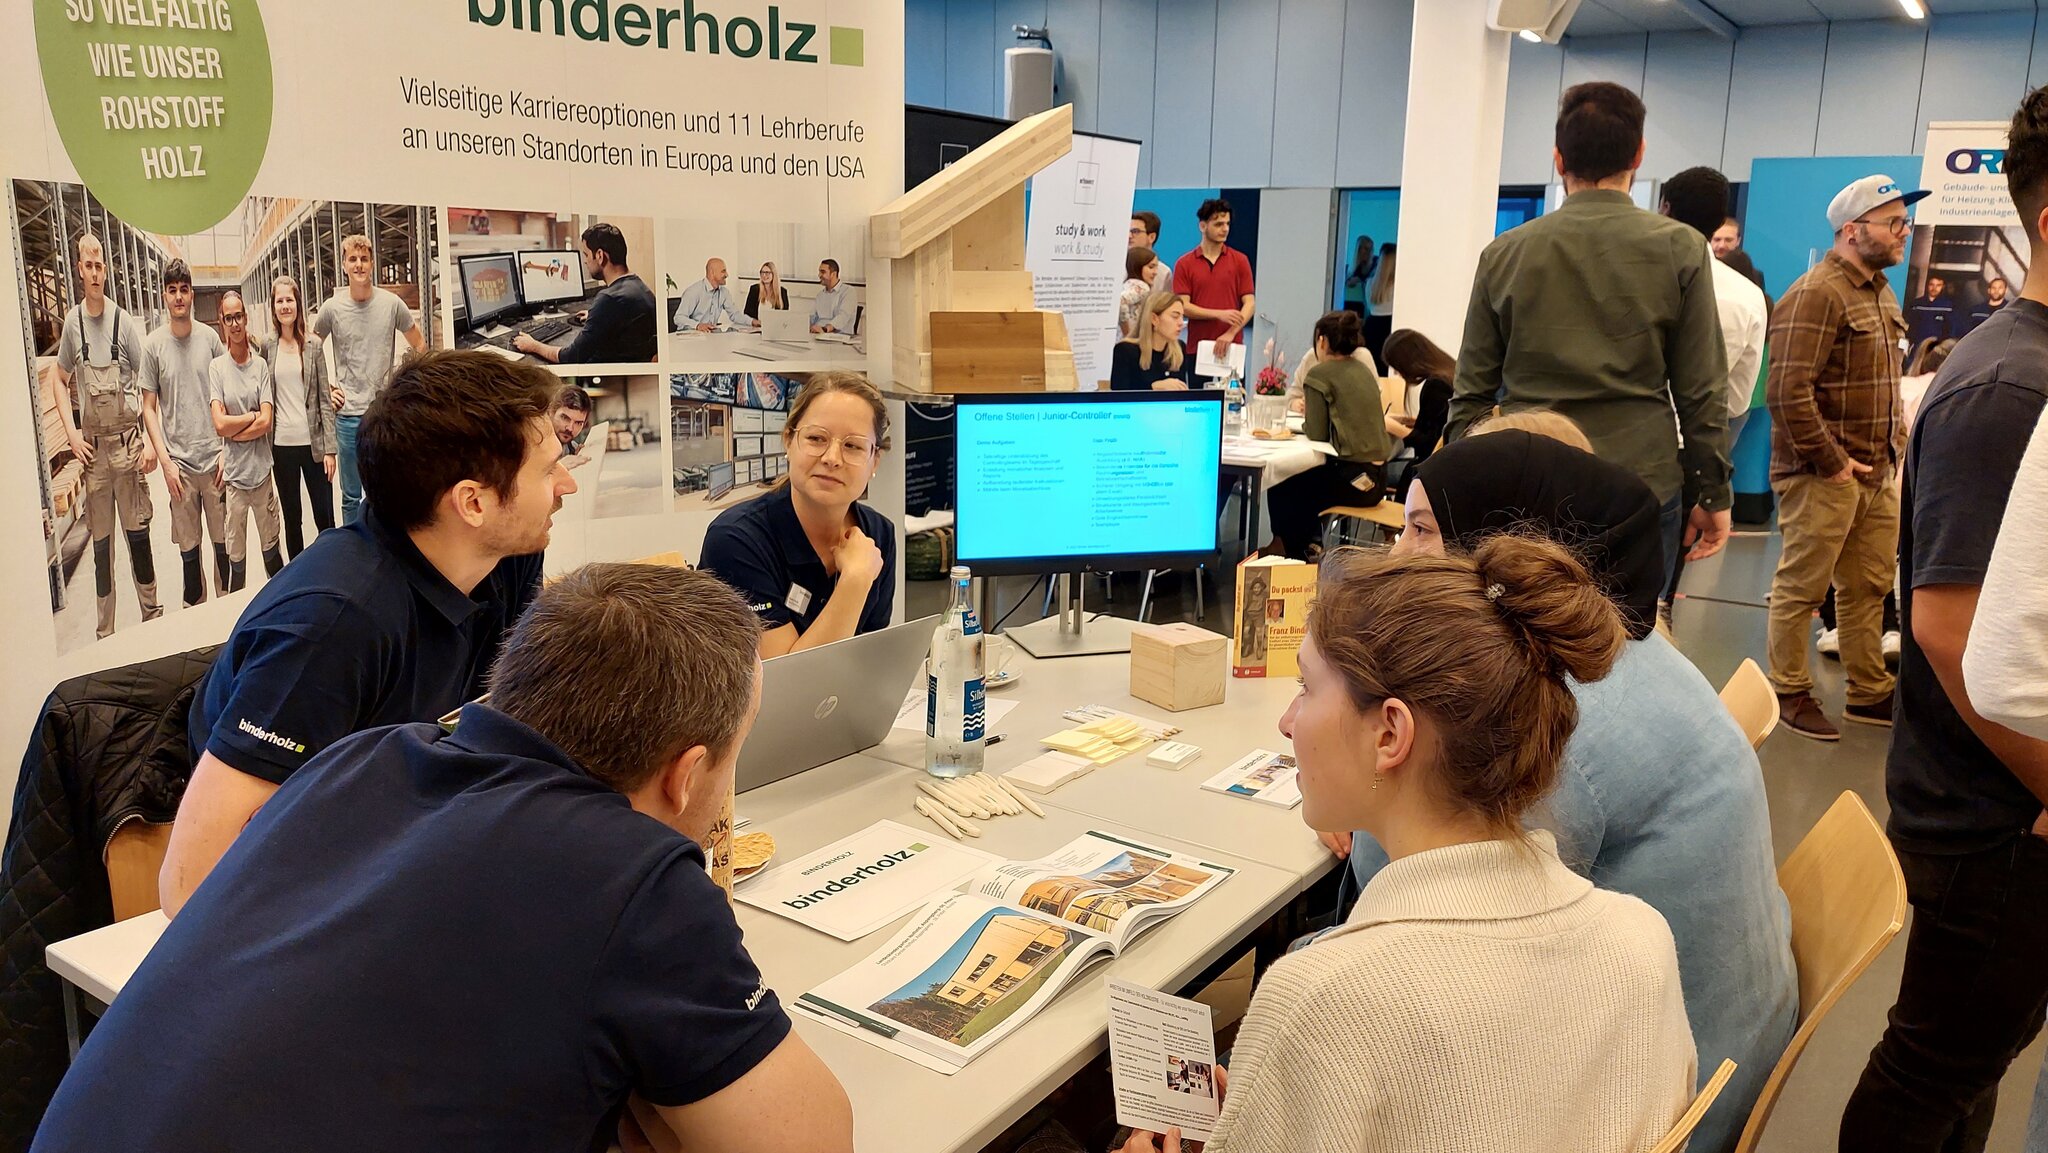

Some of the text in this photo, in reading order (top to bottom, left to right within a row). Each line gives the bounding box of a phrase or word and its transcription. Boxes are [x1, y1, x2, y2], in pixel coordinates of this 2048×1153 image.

[65, 0, 95, 23] SO
[87, 42, 224, 79] WIE UNSER
[100, 95, 226, 130] ROHSTOFF
[400, 76, 864, 142] Vielseitige Karriereoptionen und 11 Lehrberufe
[141, 145, 206, 180] HOLZ
[402, 127, 865, 178] an unseren Standorten in Europa und den USA
[1945, 148, 2009, 174] OR
[1941, 194, 1955, 204] für
[1943, 182, 1989, 191] Gebäude-
[1055, 222, 1106, 239] study & work
[1054, 241, 1104, 258] work & study
[974, 412, 1003, 421] Offene
[1006, 411, 1035, 421] Stellen
[1042, 410, 1112, 421] Junior-Controller
[1271, 585, 1280, 594] Du
[1269, 626, 1289, 635] Franz
[239, 717, 297, 751] binderholz
[801, 851, 855, 876] BINDERHOLZ
[782, 850, 915, 910] binderholz
[745, 976, 768, 1011] bind
